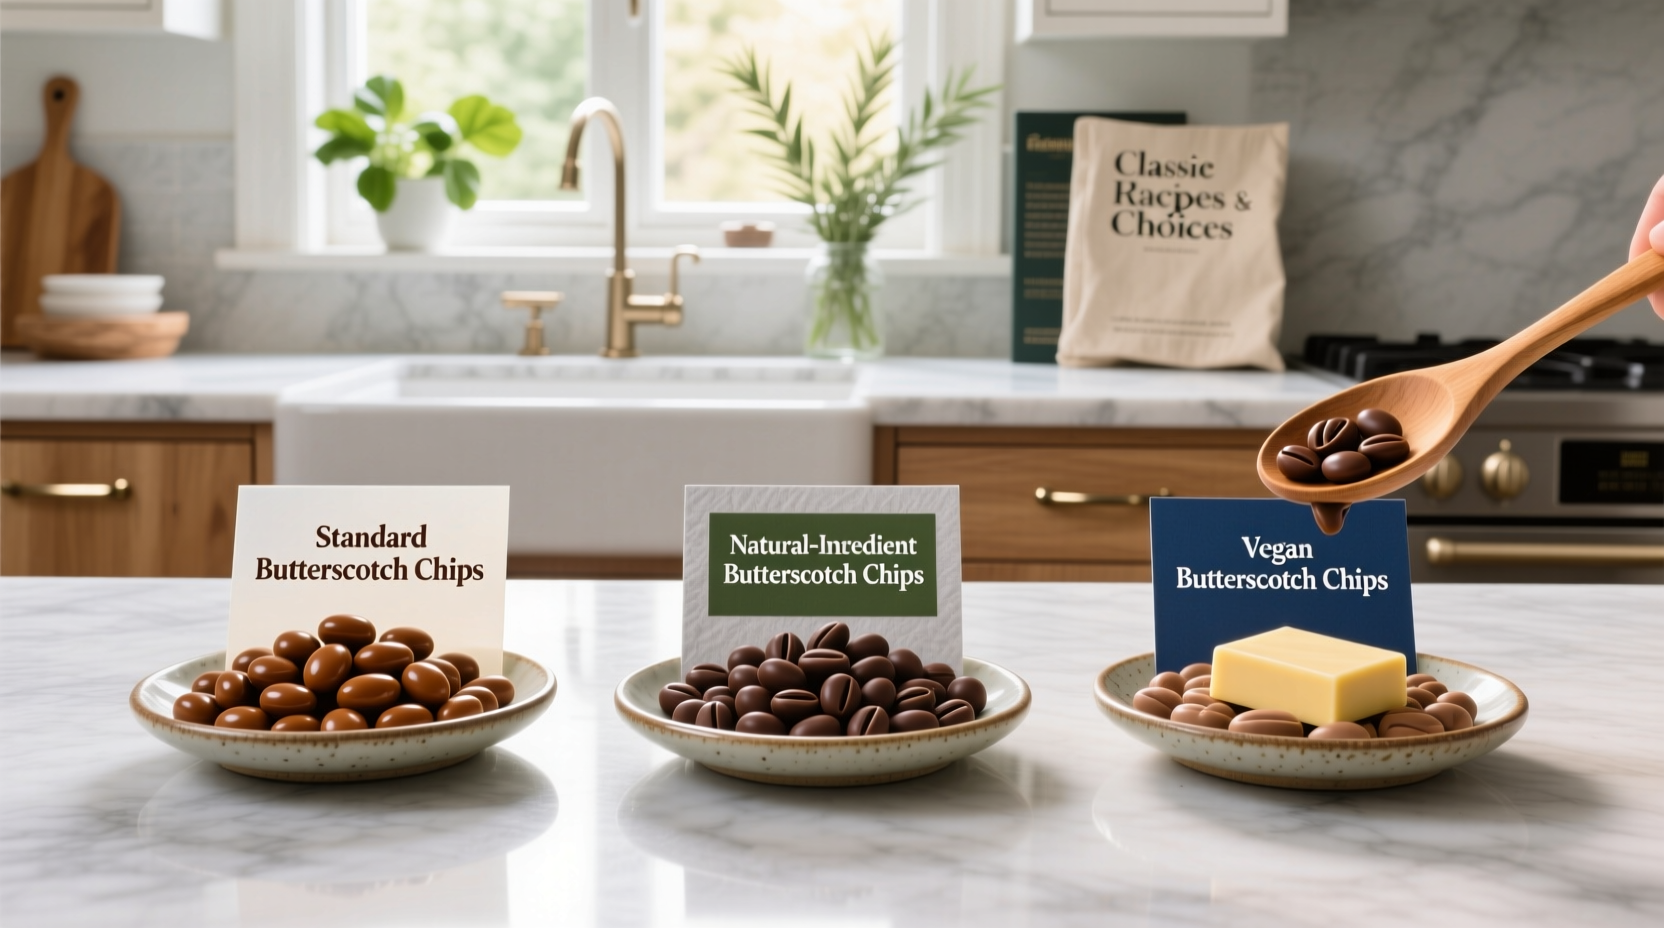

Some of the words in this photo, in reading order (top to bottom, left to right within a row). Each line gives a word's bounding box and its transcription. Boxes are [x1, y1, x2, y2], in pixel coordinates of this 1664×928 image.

[1114, 151, 1215, 178] Classic
[1234, 191, 1252, 211] &
[1111, 210, 1233, 239] Choices
[316, 524, 427, 548] Standard
[1241, 536, 1314, 565] Vegan
[255, 557, 408, 580] Butterscotch
[414, 557, 484, 587] Chips
[723, 563, 857, 584] Butterscotch
[862, 563, 925, 592] Chips
[1176, 567, 1317, 590] Butterscotch
[1322, 567, 1389, 597] Chips
